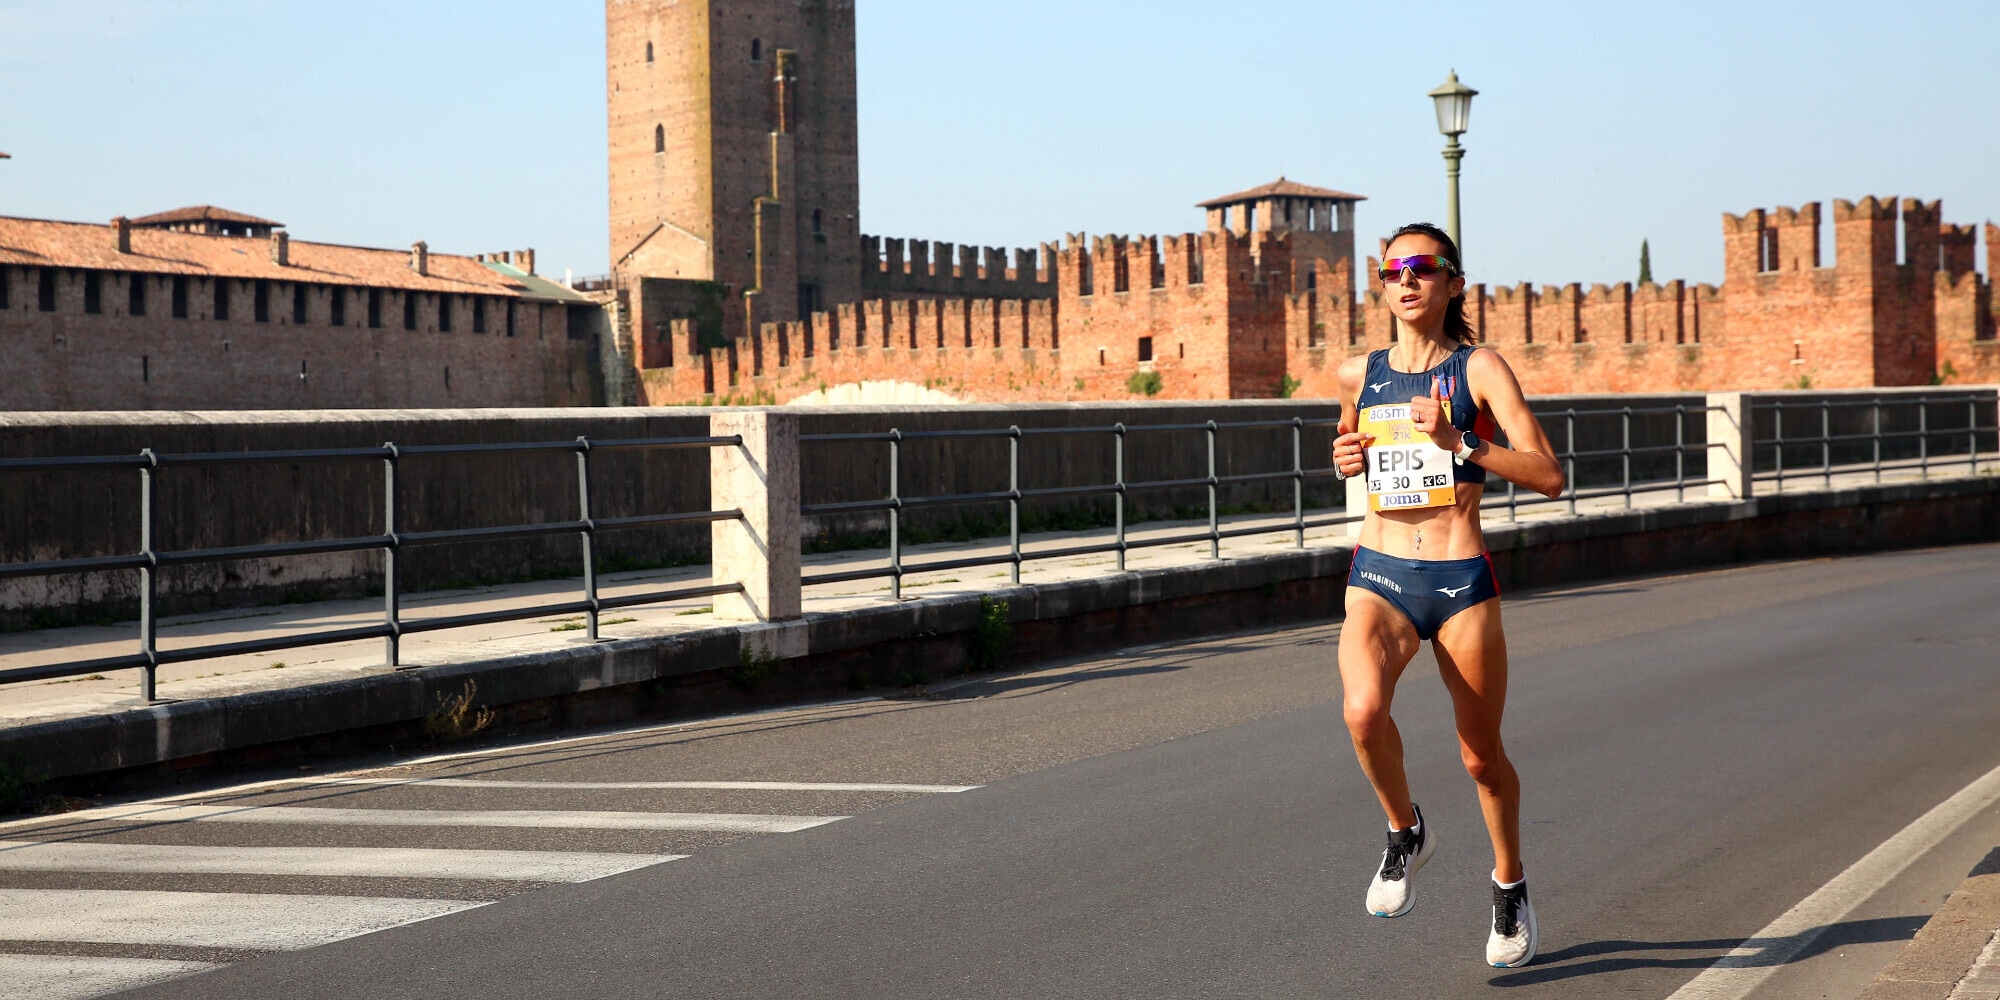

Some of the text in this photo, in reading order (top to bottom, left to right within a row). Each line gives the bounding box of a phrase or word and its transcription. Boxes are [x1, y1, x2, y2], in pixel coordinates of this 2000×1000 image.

[1393, 430, 1410, 440] 21k
[1378, 448, 1424, 472] EPIS
[1392, 476, 1410, 489] 30
